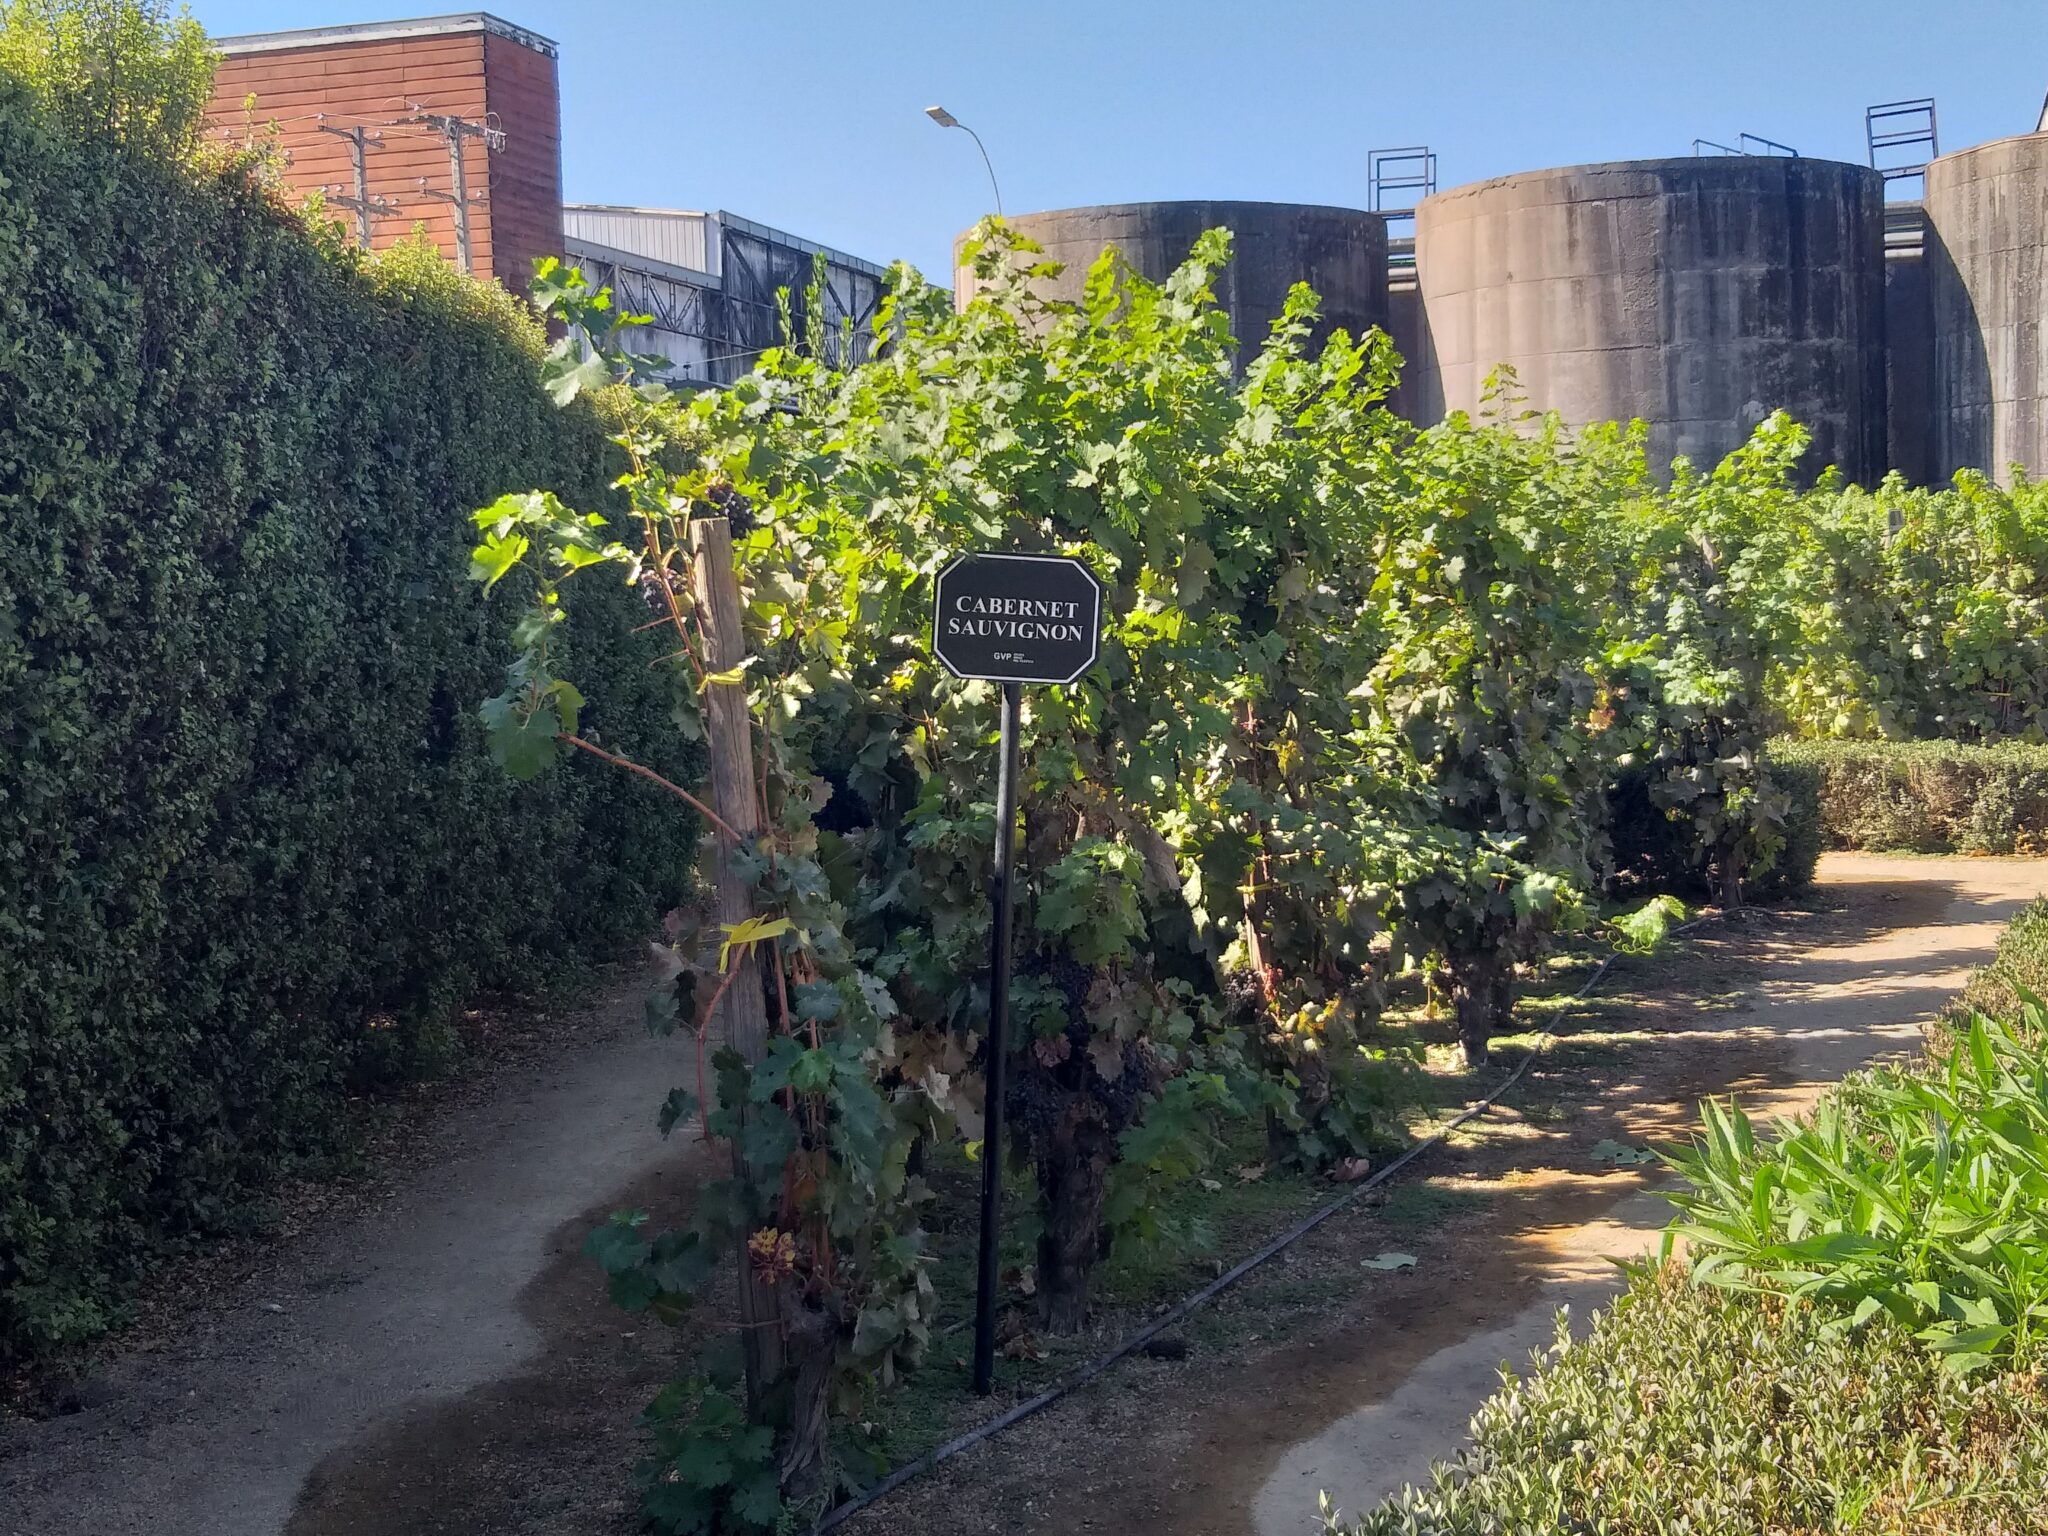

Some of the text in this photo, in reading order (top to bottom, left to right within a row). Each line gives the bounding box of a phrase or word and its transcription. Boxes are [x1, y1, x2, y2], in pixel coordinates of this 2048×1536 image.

[956, 596, 1080, 619] CABERNET
[948, 618, 1083, 642] SAUVIGNON
[993, 652, 1012, 661] GVP
